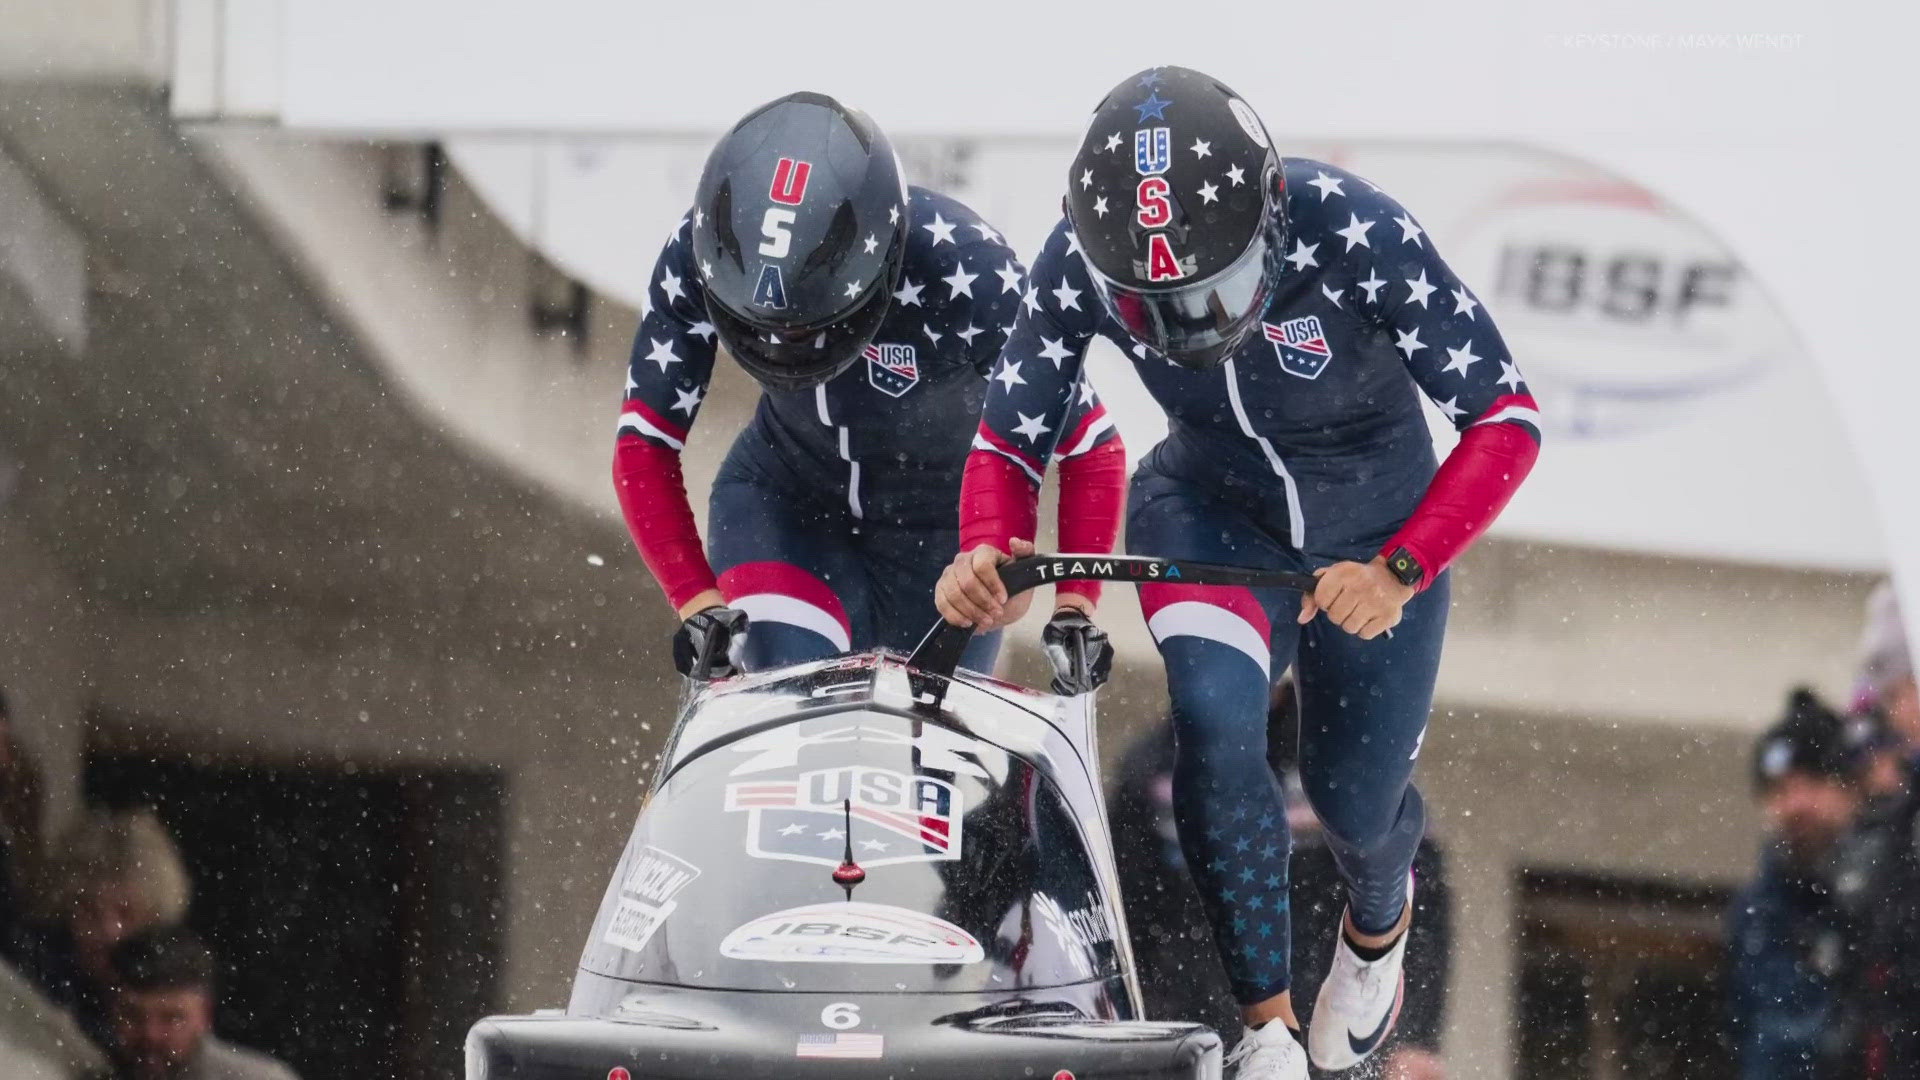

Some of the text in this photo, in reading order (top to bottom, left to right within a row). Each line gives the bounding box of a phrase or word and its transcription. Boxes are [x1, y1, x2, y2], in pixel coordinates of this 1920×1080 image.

[1496, 246, 1740, 328] IBSF
[1284, 319, 1321, 344] USA
[881, 346, 914, 365] USA
[1036, 561, 1181, 580] TEAM USA
[809, 771, 951, 817] USA
[771, 922, 937, 947] IBSF
[820, 1002, 861, 1030] 6
